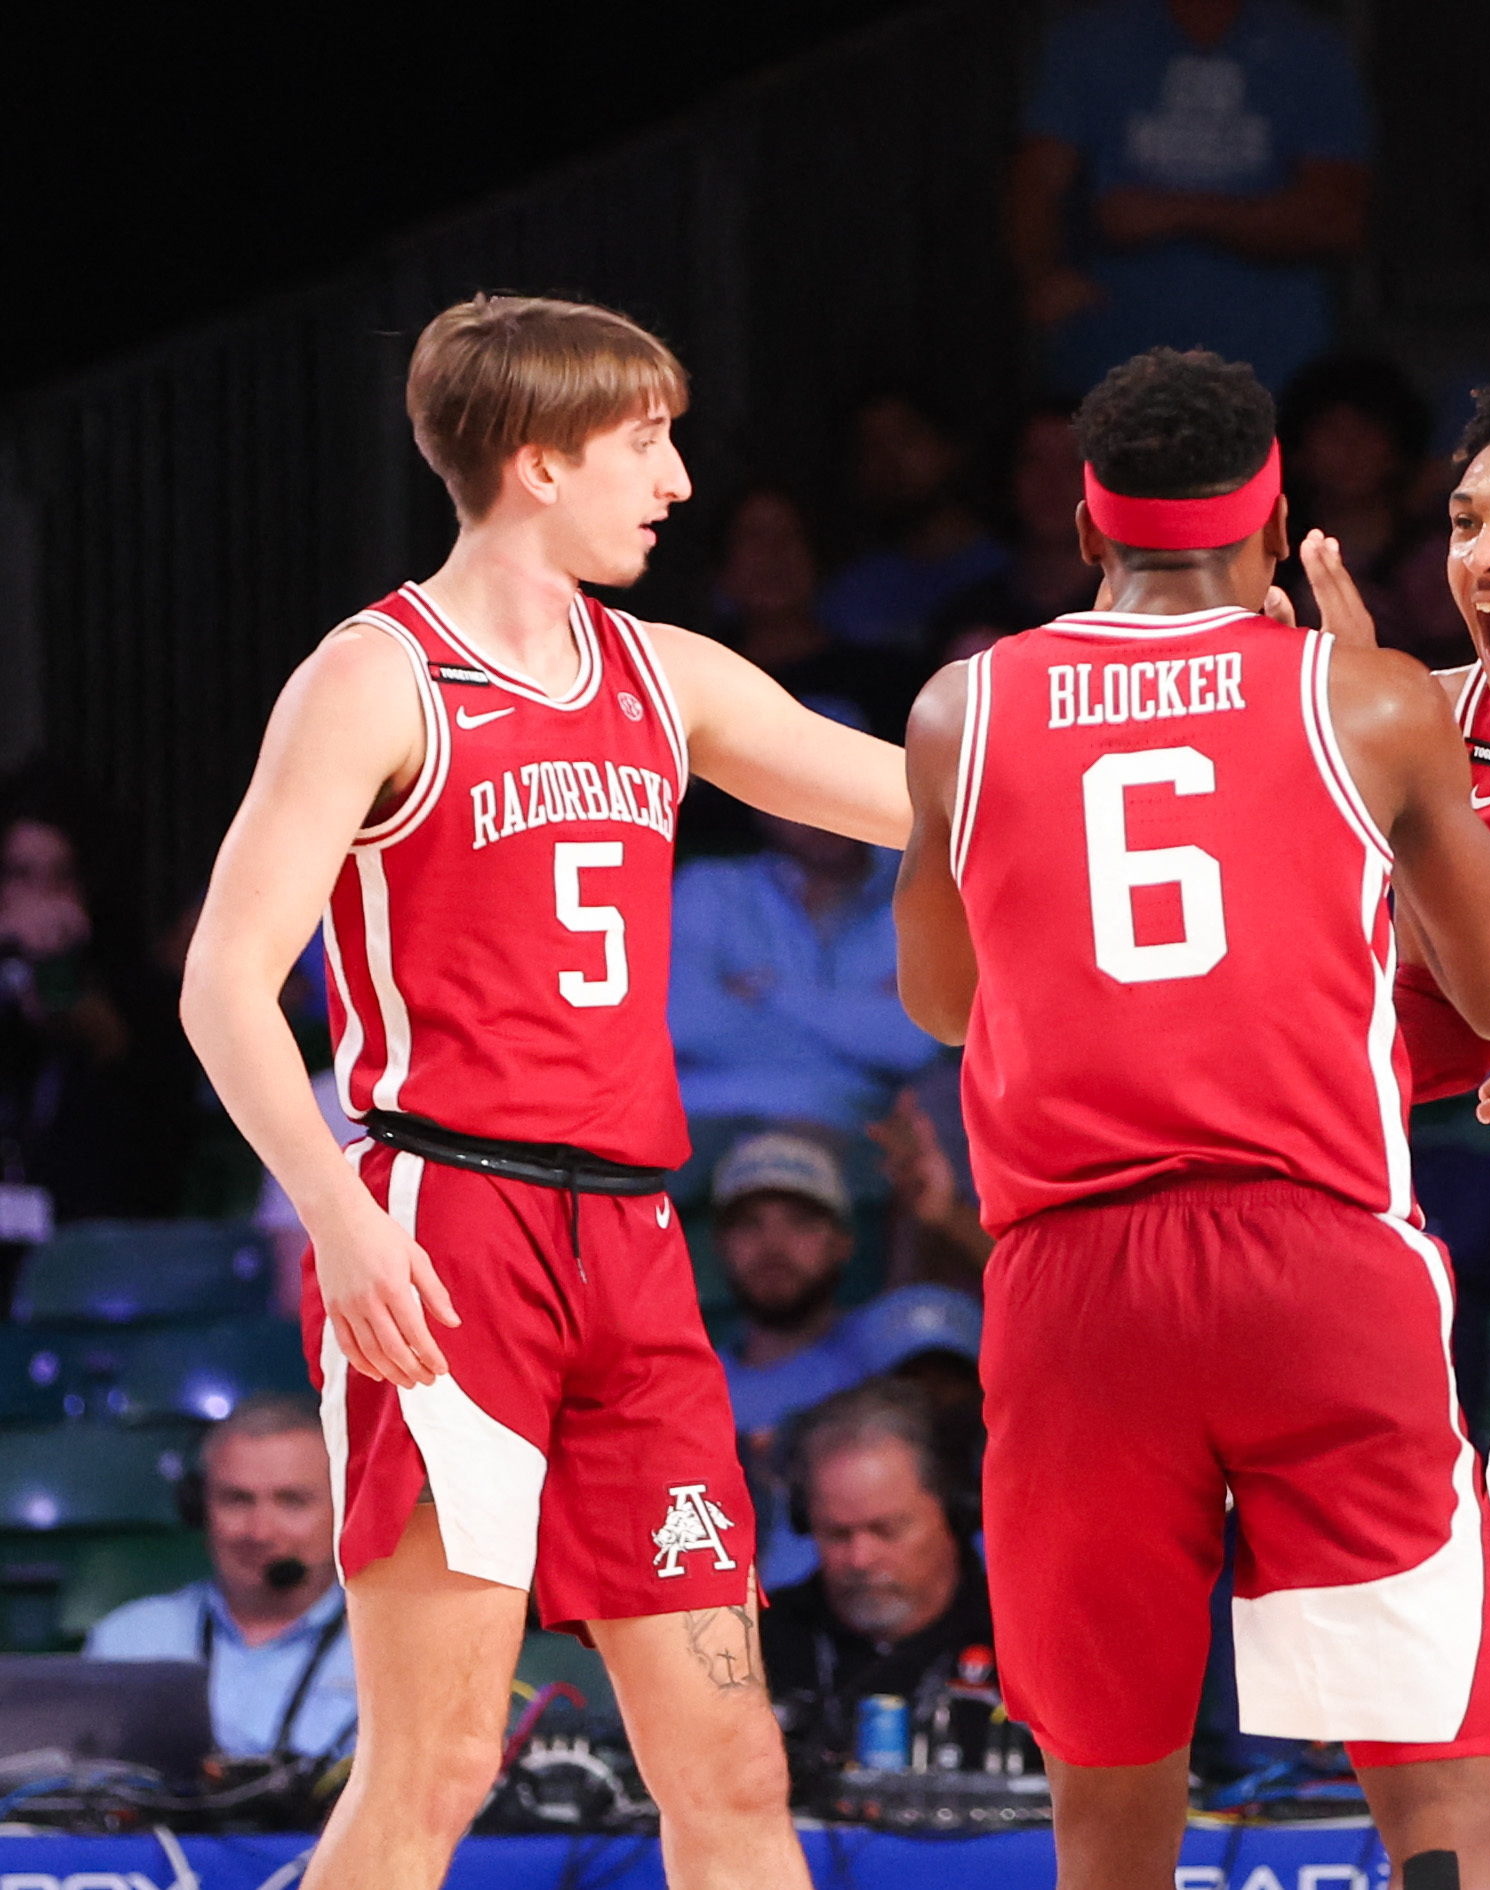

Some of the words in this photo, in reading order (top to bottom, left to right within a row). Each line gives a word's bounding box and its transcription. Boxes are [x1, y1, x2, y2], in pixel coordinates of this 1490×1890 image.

[1048, 652, 1246, 729] BLOCKER
[470, 760, 674, 850] RAZORBACKS
[1082, 745, 1228, 984] 6
[553, 841, 629, 1008] 5
